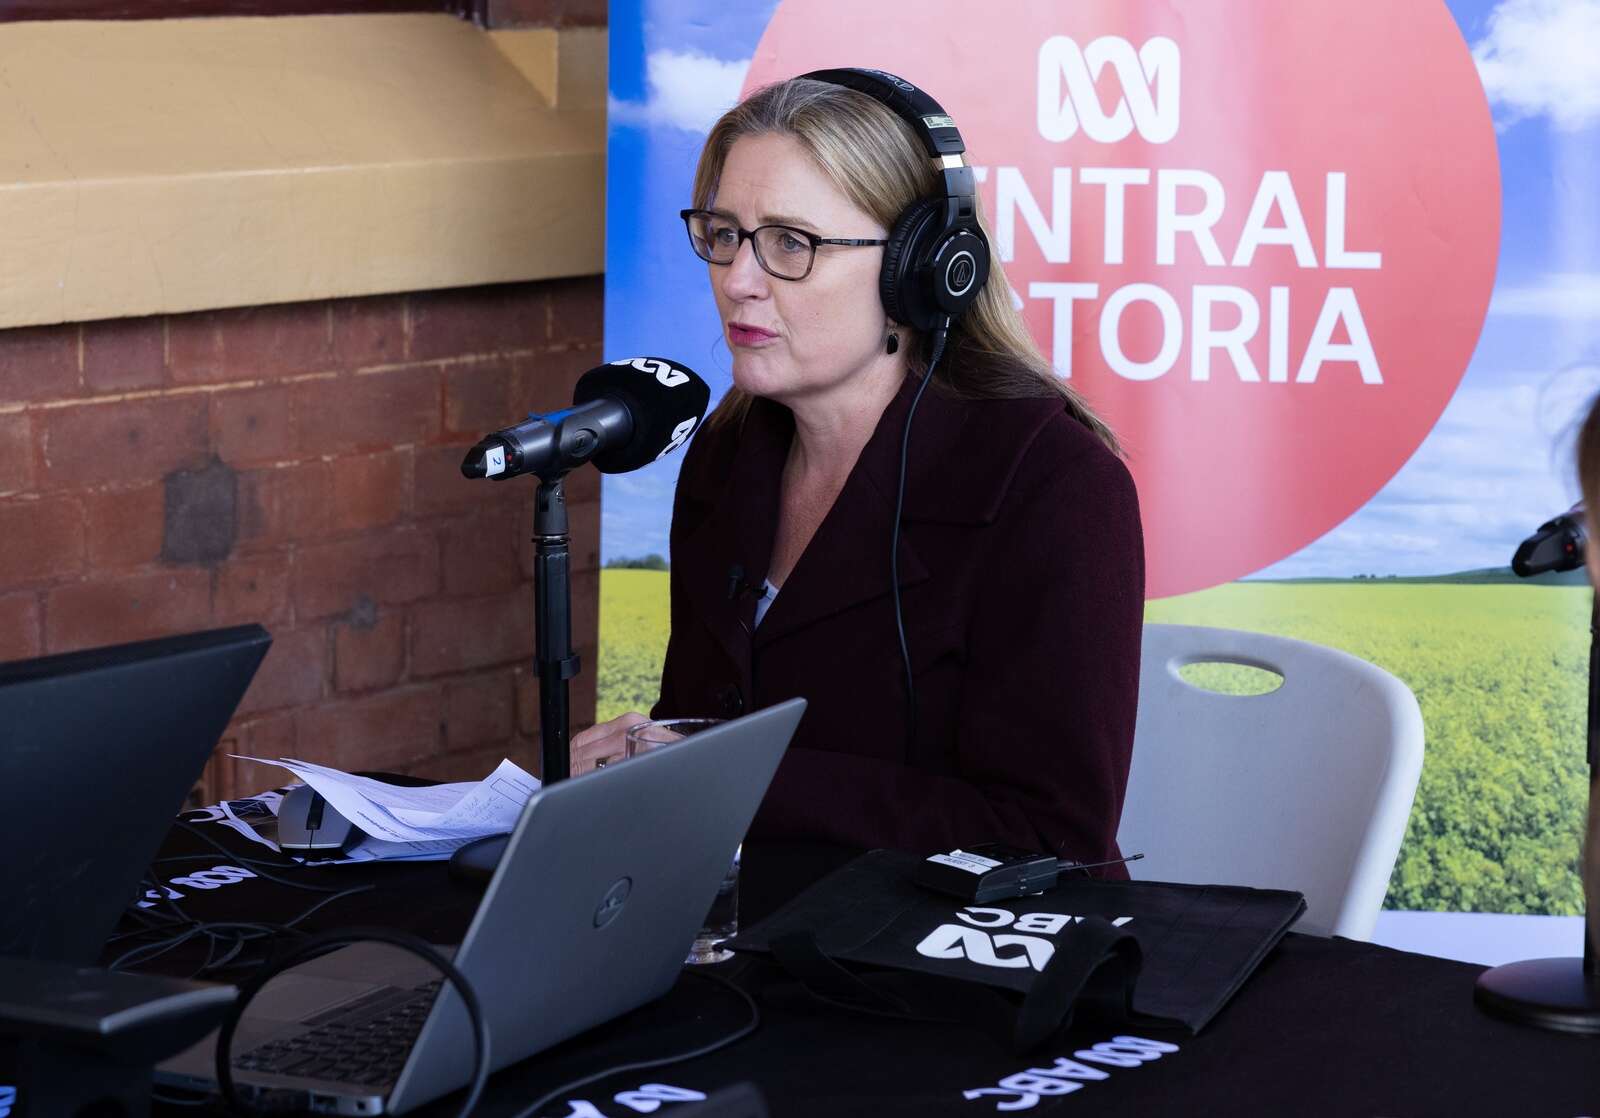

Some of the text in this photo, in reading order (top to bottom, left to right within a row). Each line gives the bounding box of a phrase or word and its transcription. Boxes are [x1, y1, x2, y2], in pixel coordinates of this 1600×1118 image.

[974, 166, 1382, 269] NTRAL
[1008, 282, 1385, 385] TORIA
[962, 1056, 1111, 1112] ABC
